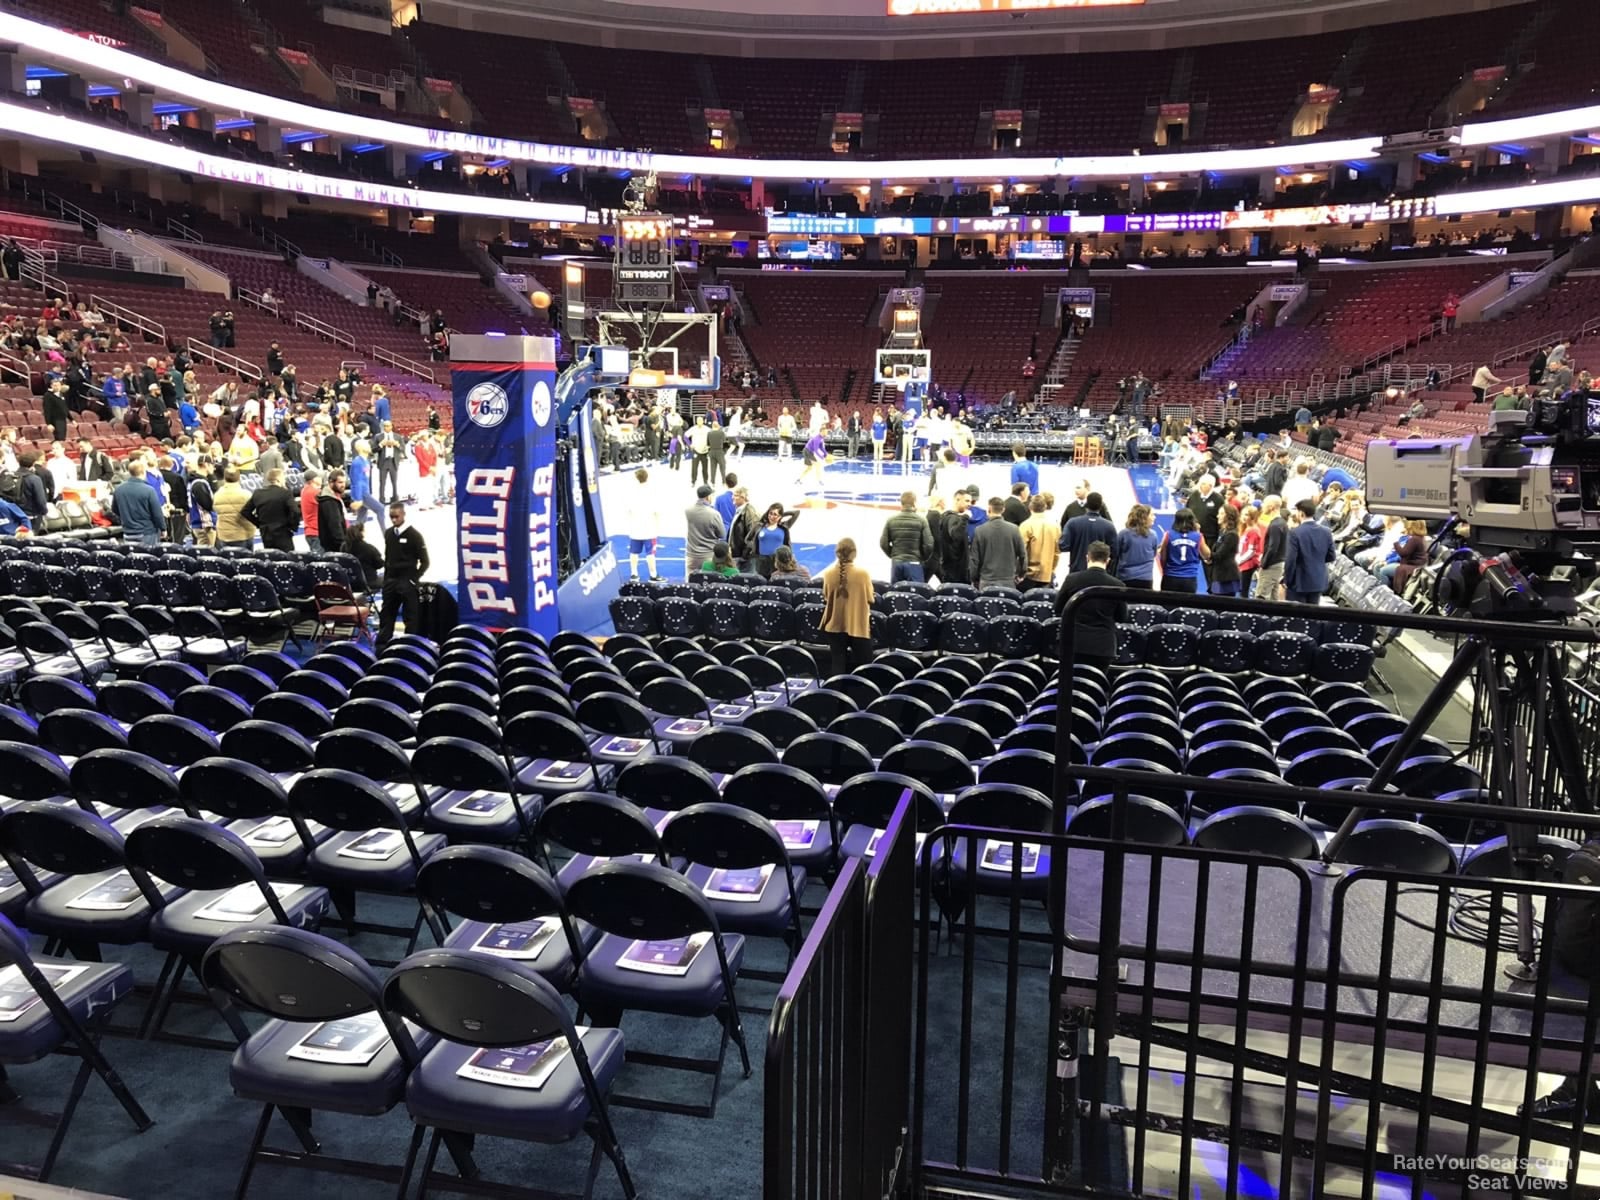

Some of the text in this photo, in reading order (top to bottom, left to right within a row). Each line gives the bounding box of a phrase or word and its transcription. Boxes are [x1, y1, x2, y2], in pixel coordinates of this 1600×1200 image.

[635, 270, 669, 279] TISSOT
[471, 399, 504, 416] 76ers
[461, 466, 516, 615] PHILA
[529, 463, 555, 612] PHILA
